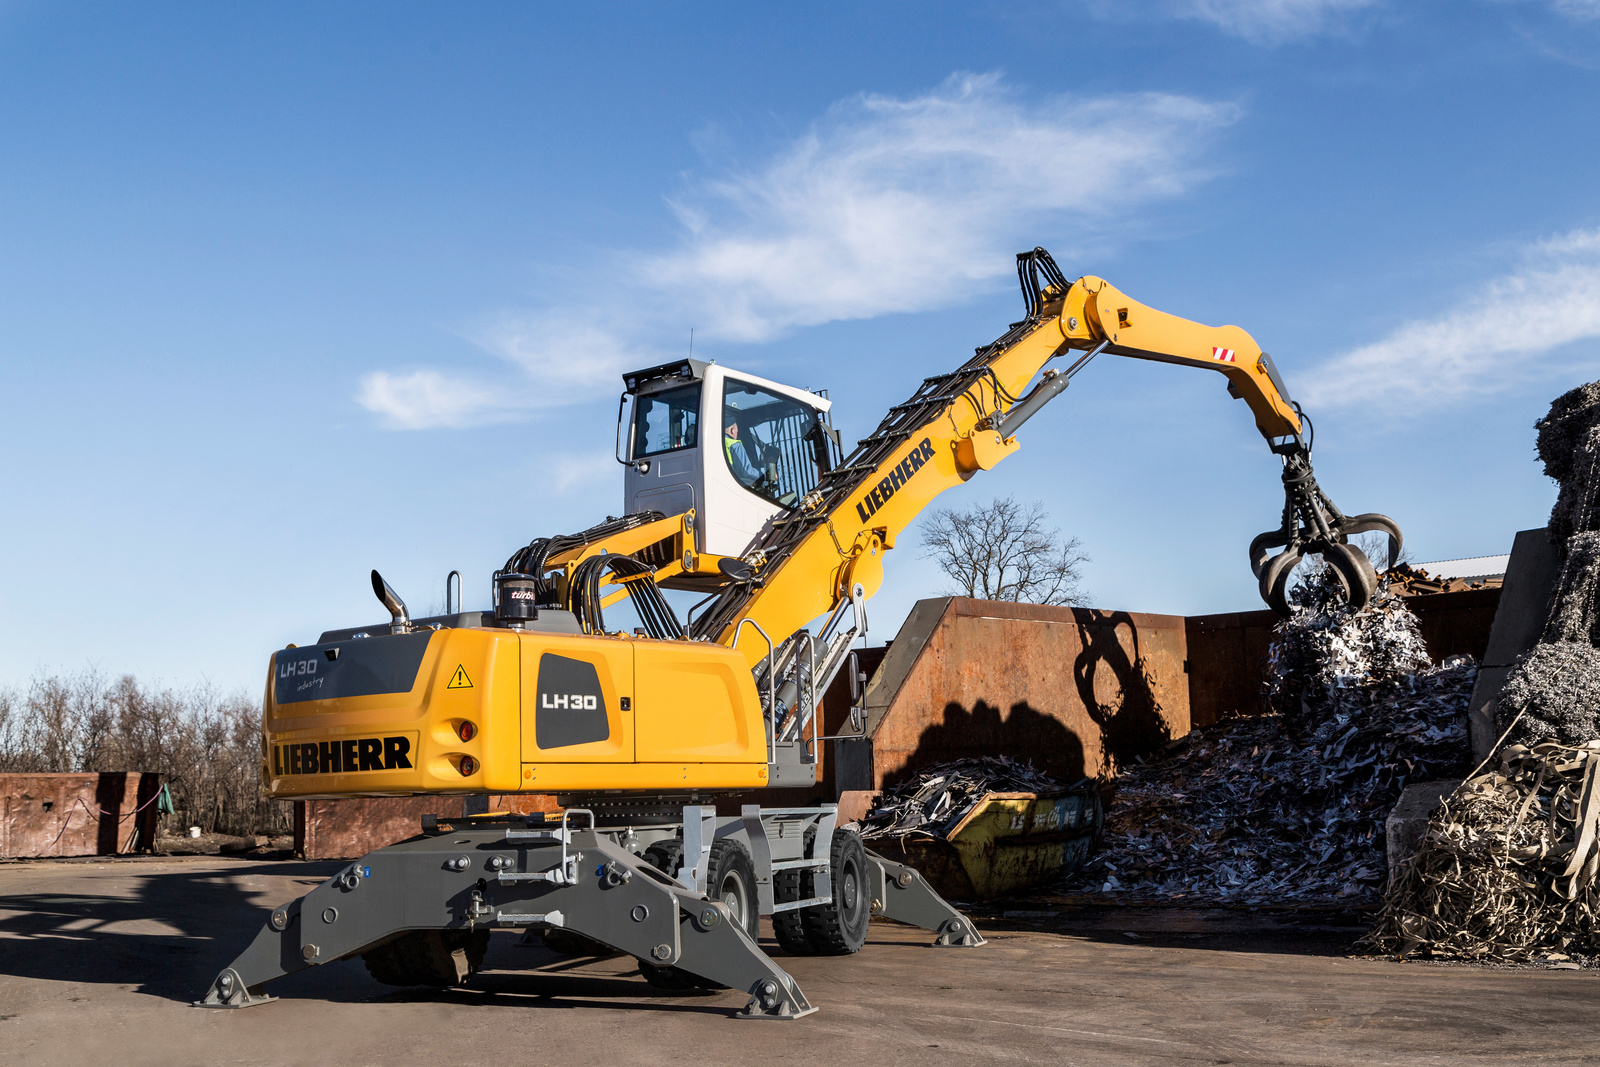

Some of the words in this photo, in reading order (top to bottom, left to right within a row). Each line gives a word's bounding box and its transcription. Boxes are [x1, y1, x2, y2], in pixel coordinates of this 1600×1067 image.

[855, 437, 936, 525] LIEBHERR
[280, 659, 318, 678] LH30
[297, 676, 324, 692] industry
[542, 693, 597, 710] LH30
[274, 736, 413, 776] LIEBHERR
